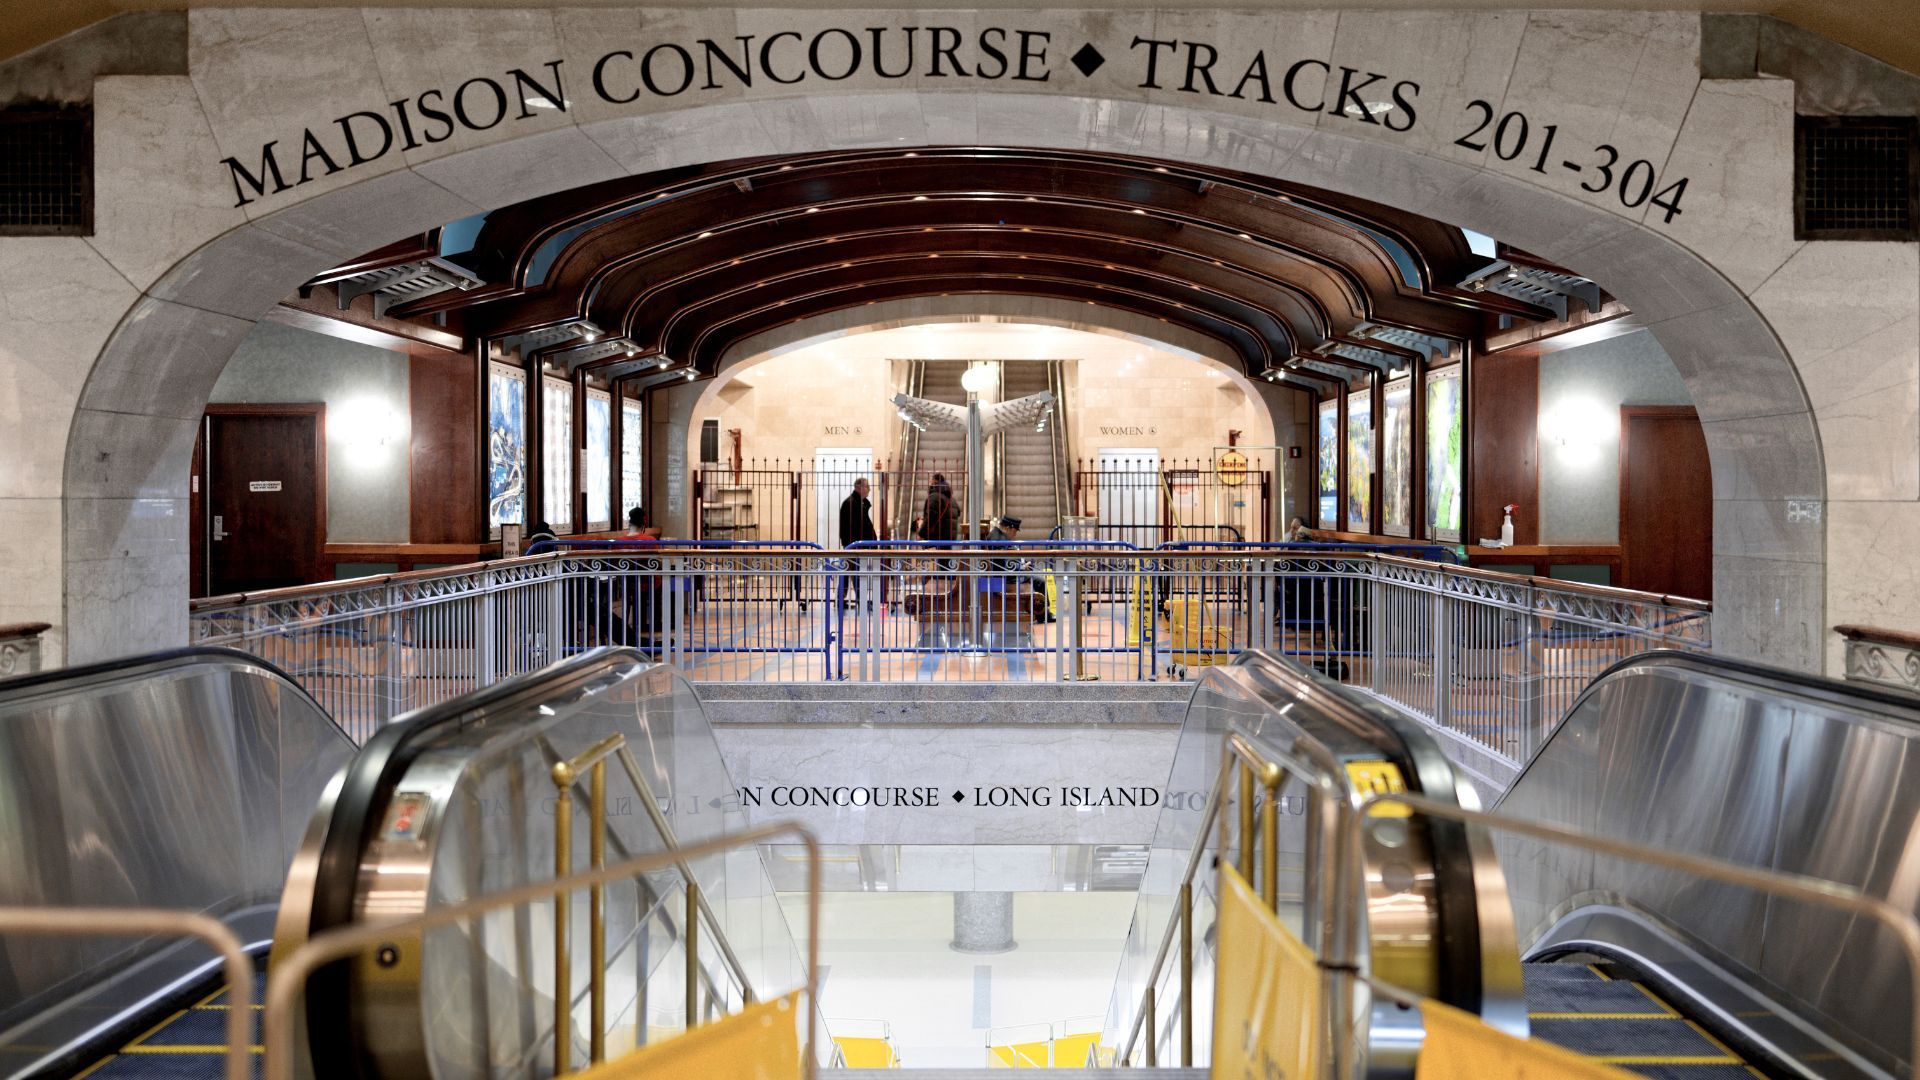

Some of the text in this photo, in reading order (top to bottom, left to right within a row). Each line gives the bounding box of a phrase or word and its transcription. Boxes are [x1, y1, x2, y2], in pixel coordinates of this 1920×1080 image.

[219, 26, 1690, 225] MADISON CONCOURSE TRACKS 201-304
[824, 426, 849, 435] MEN
[1099, 426, 1144, 436] WOMEN
[771, 786, 939, 807] CONCOURSE
[974, 786, 1052, 807] LONG
[1061, 786, 1160, 807] ISLAND
